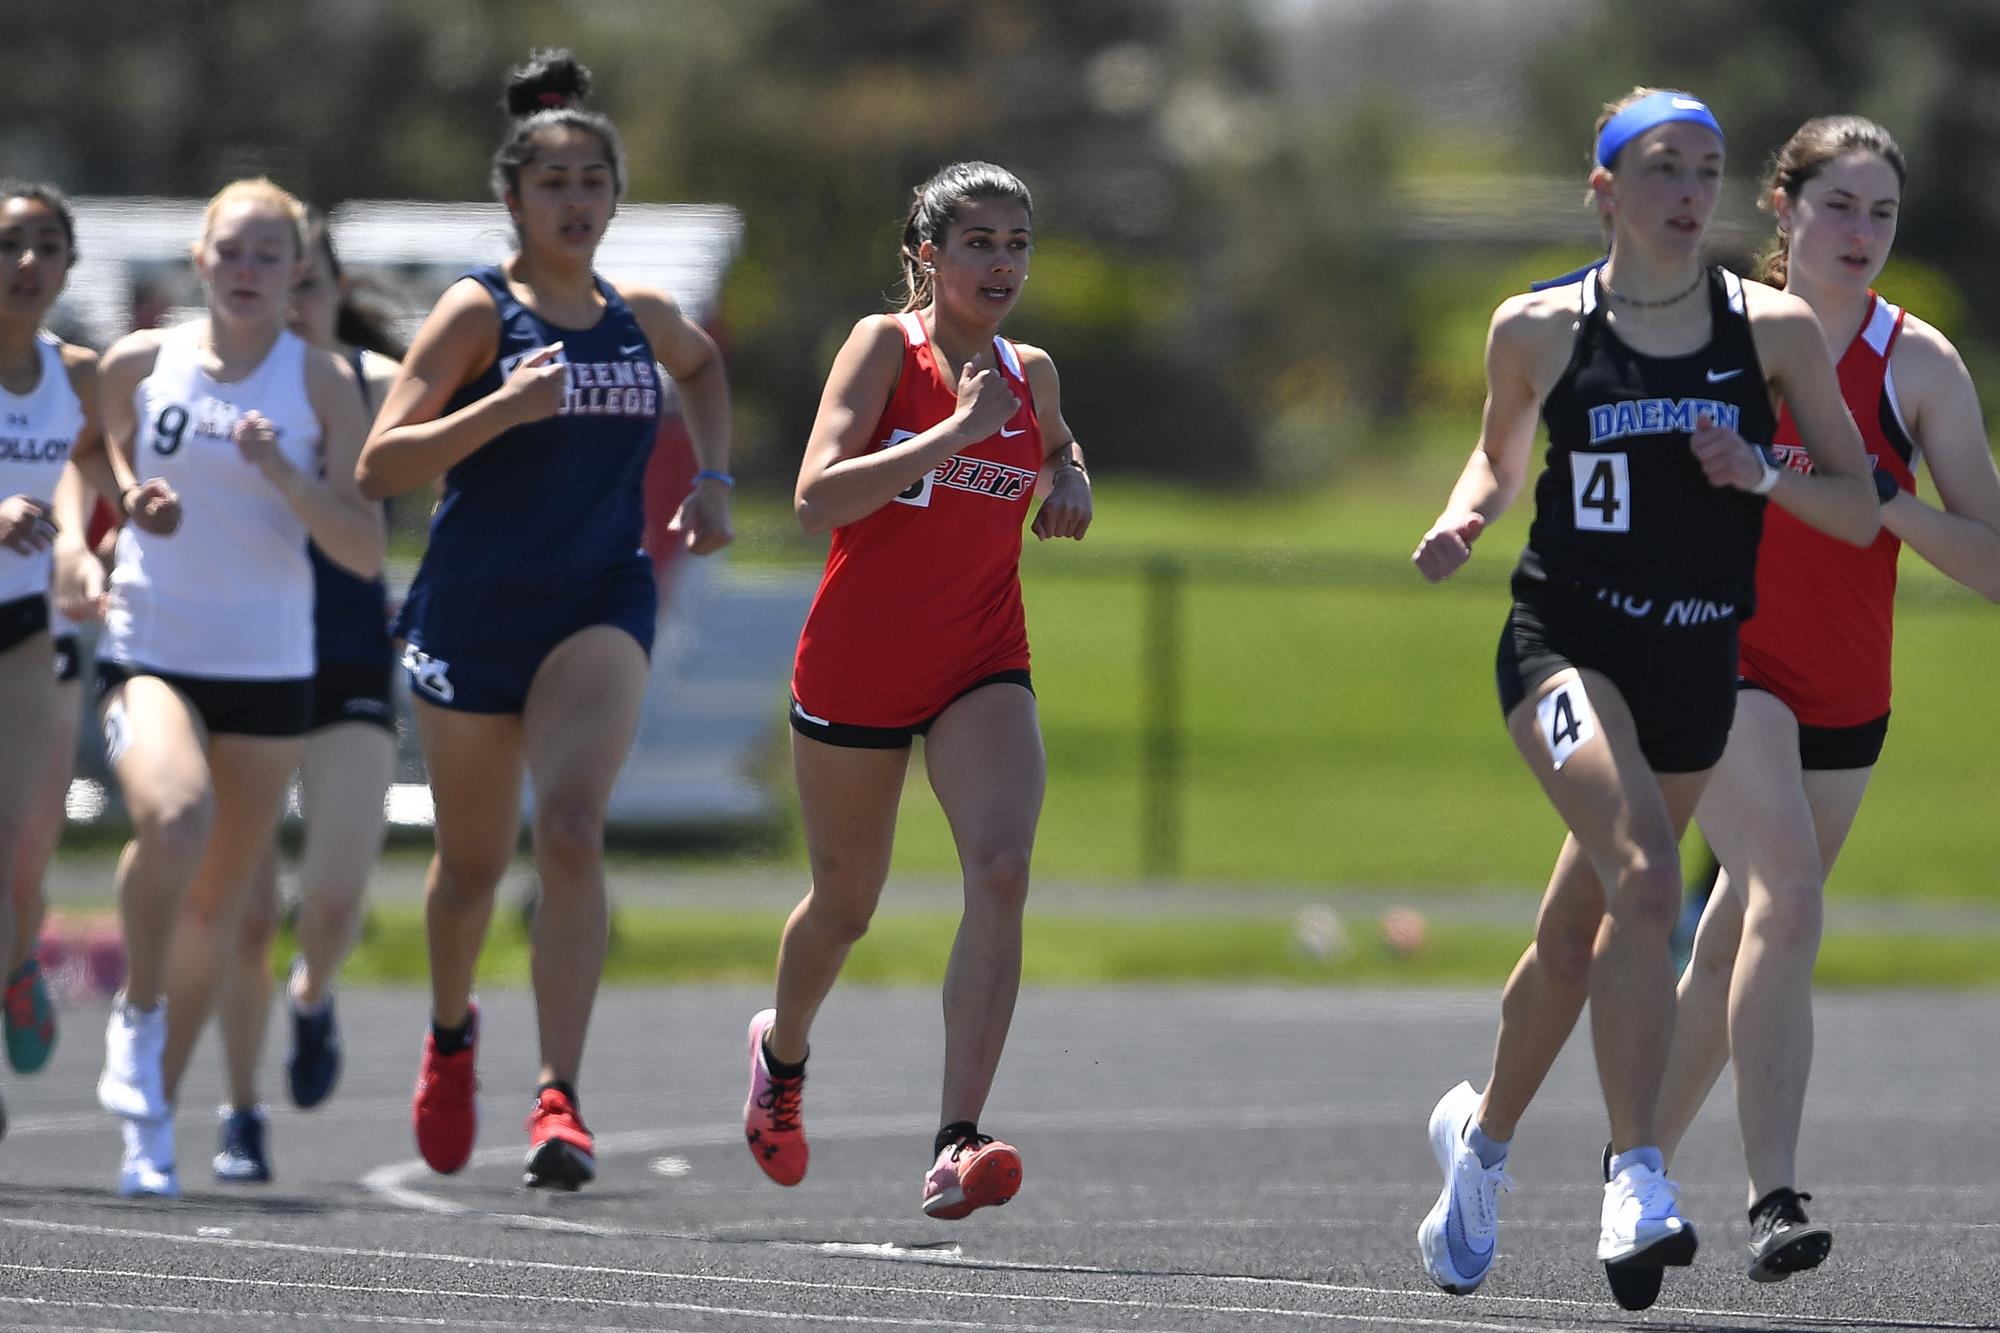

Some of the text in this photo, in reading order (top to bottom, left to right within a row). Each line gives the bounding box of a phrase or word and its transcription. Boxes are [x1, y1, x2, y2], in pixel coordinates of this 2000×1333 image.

[570, 361, 655, 387] EENS
[153, 404, 190, 456] 9
[933, 455, 1037, 499] BERTS
[1581, 459, 1622, 524] 4
[1553, 690, 1582, 746] 4
